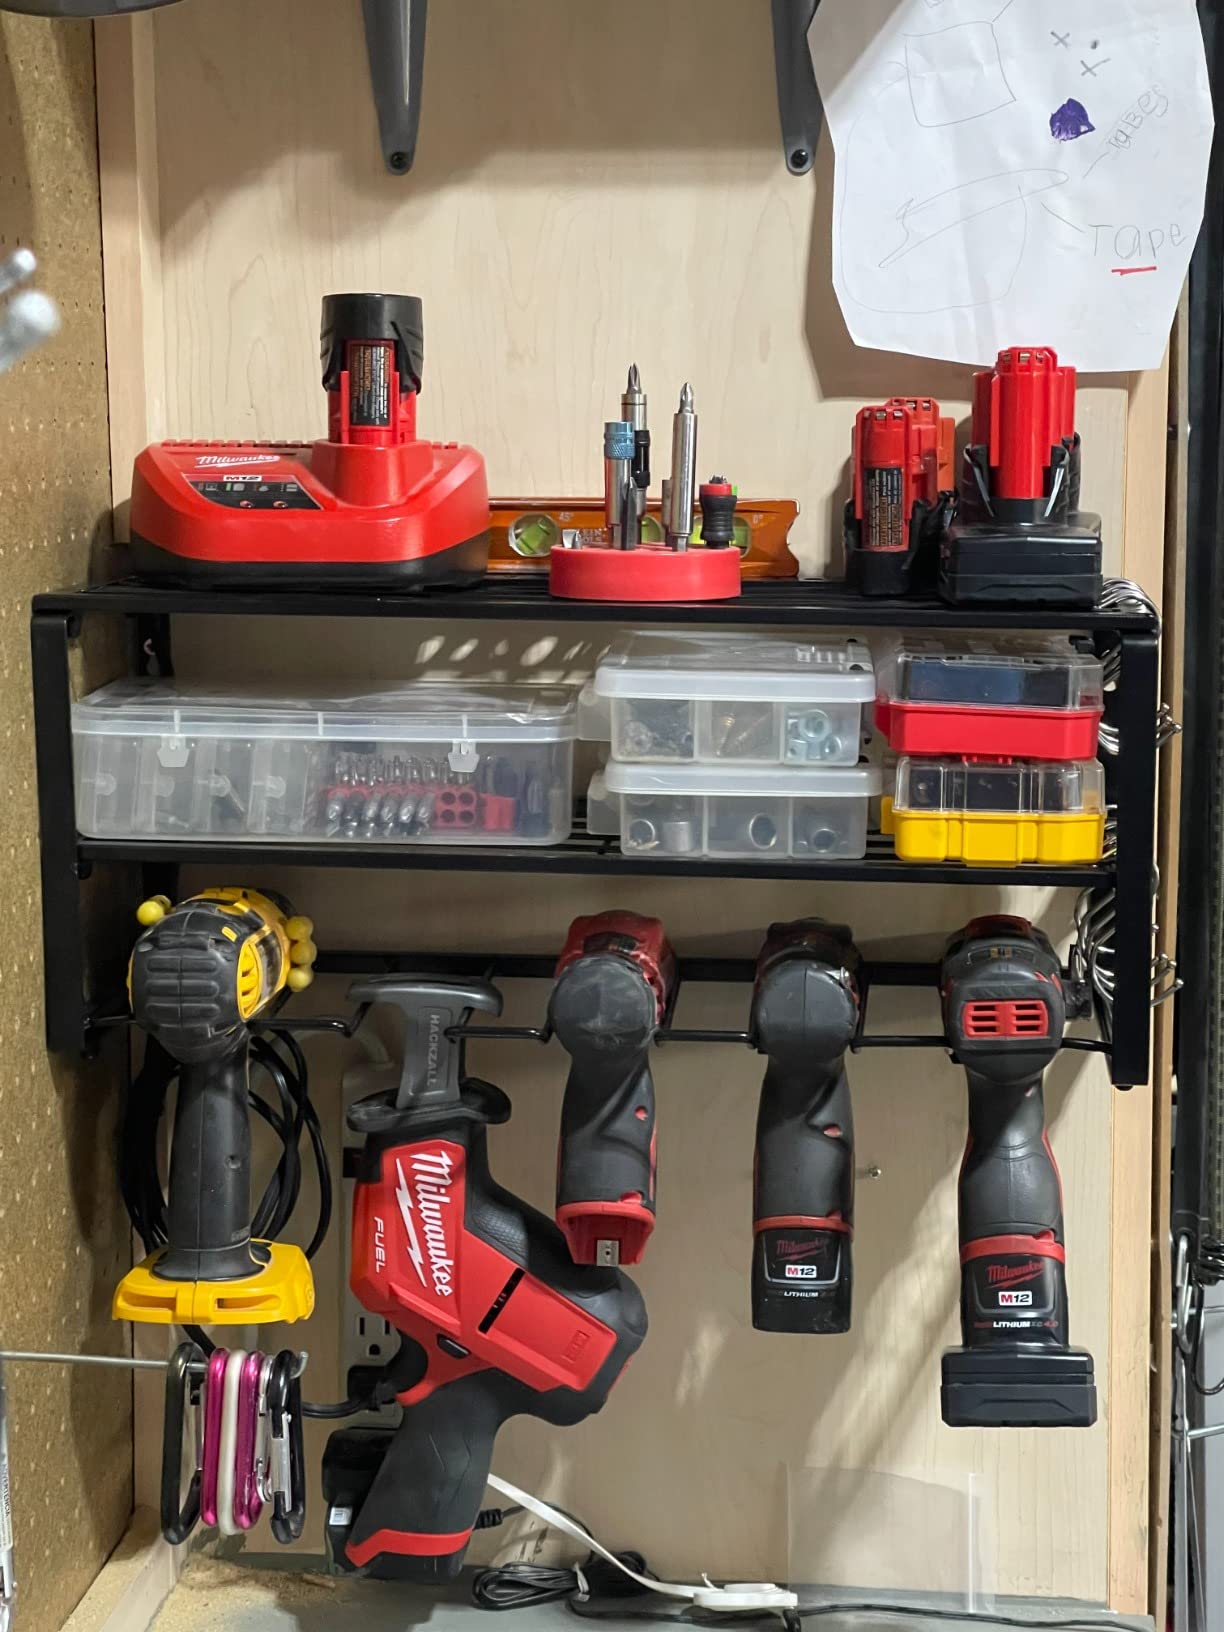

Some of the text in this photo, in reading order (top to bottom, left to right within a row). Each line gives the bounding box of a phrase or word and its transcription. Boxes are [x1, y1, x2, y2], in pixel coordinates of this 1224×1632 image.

[195, 454, 281, 466] Milwaukee
[426, 1013, 441, 1087] HACKZALL
[409, 1150, 454, 1297] Milwaukee
[373, 1216, 386, 1273] FUEL
[786, 1266, 816, 1277] M12
[783, 1290, 819, 1298] LITHIUM
[1000, 1293, 1031, 1304] M12
[992, 1320, 1031, 1329] LITHIUM
